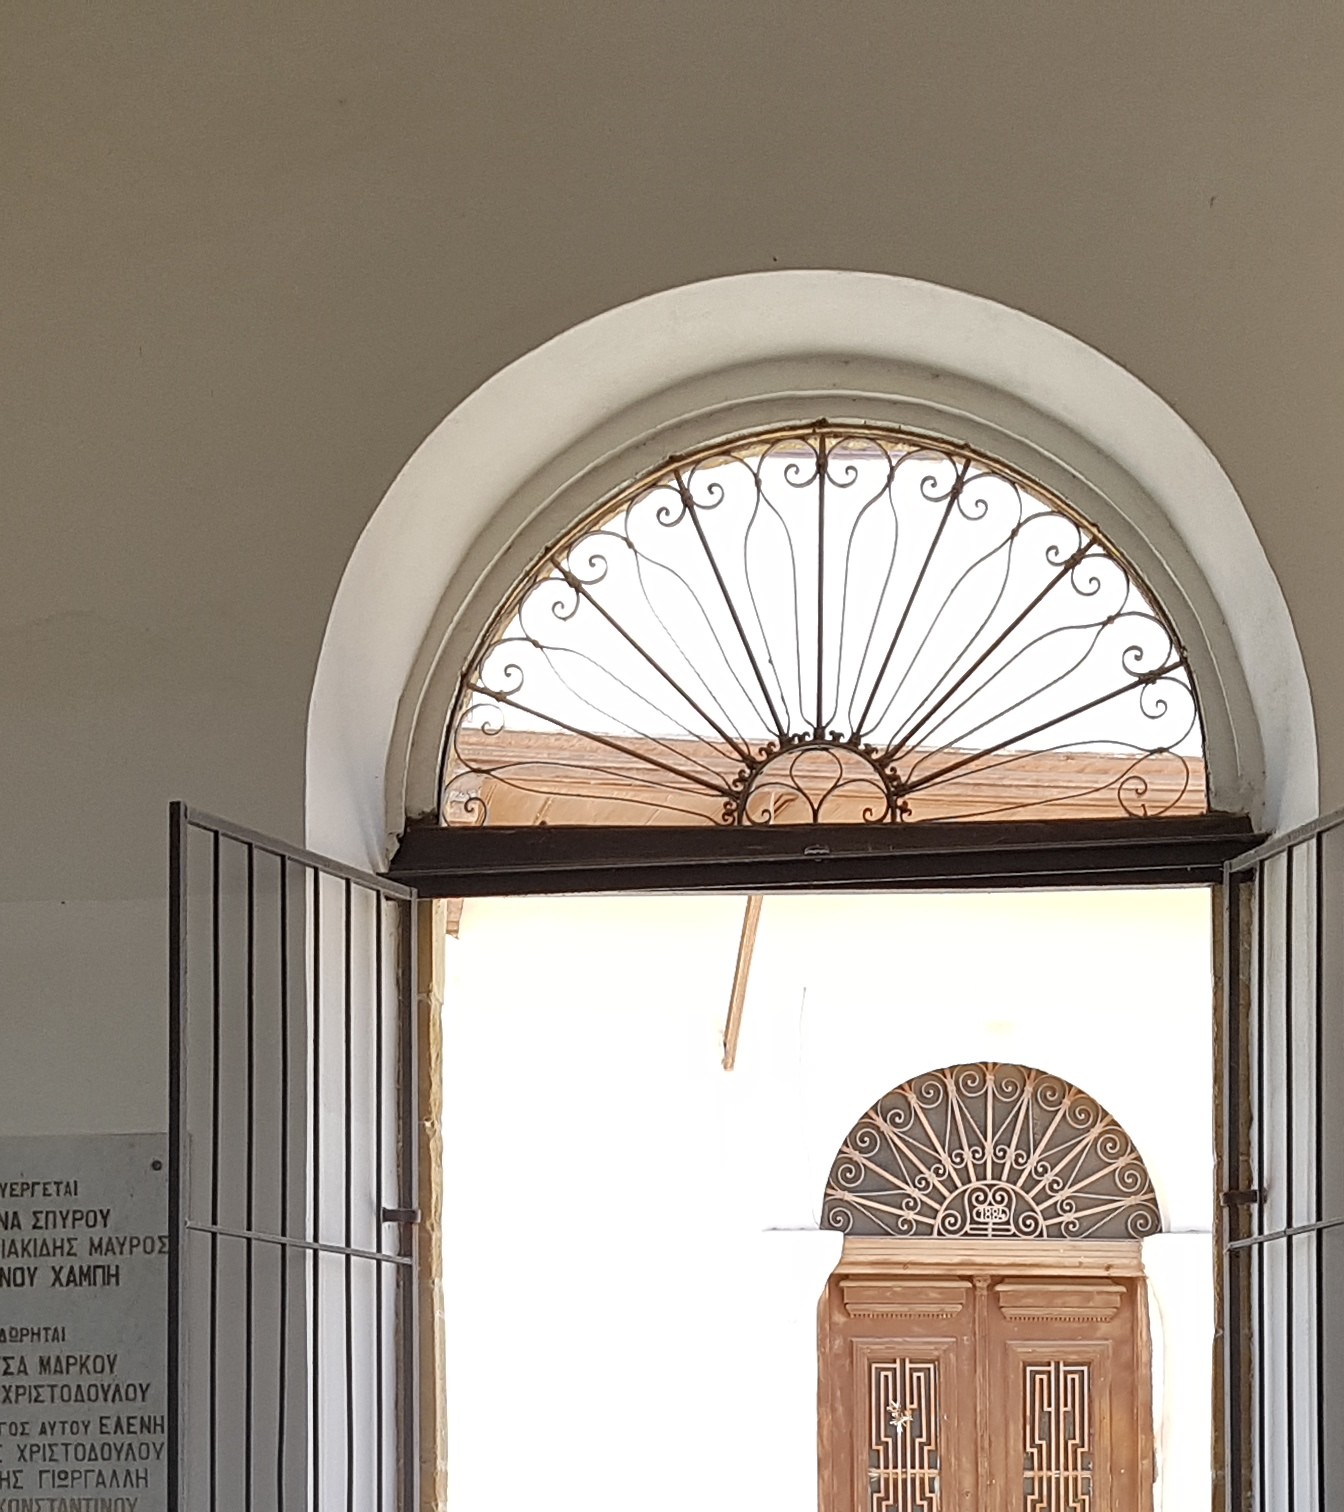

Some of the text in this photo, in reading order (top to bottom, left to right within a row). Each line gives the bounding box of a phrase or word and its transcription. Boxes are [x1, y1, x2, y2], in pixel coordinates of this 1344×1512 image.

[32, 1208, 111, 1231] ΣΠΥΡΟΥ
[88, 1234, 171, 1257] ΜΑΥΡΟΣ
[51, 1264, 120, 1288] ΧΑΜΠΗ
[38, 1353, 118, 1376] ΜΑΡΚΟΥ
[2, 1382, 151, 1404] ΧΡΙΣΤΟΔΟΥΛΟΥ
[38, 1419, 91, 1437] ΑΥΤΟΥ
[98, 1414, 165, 1436] ΕΛΕΝΗ
[16, 1440, 165, 1463] ΧΡΙΣΤΟΔΟΥΛΟΥ
[38, 1467, 150, 1489] ΓΙΩΡΓΑΛΛΗ
